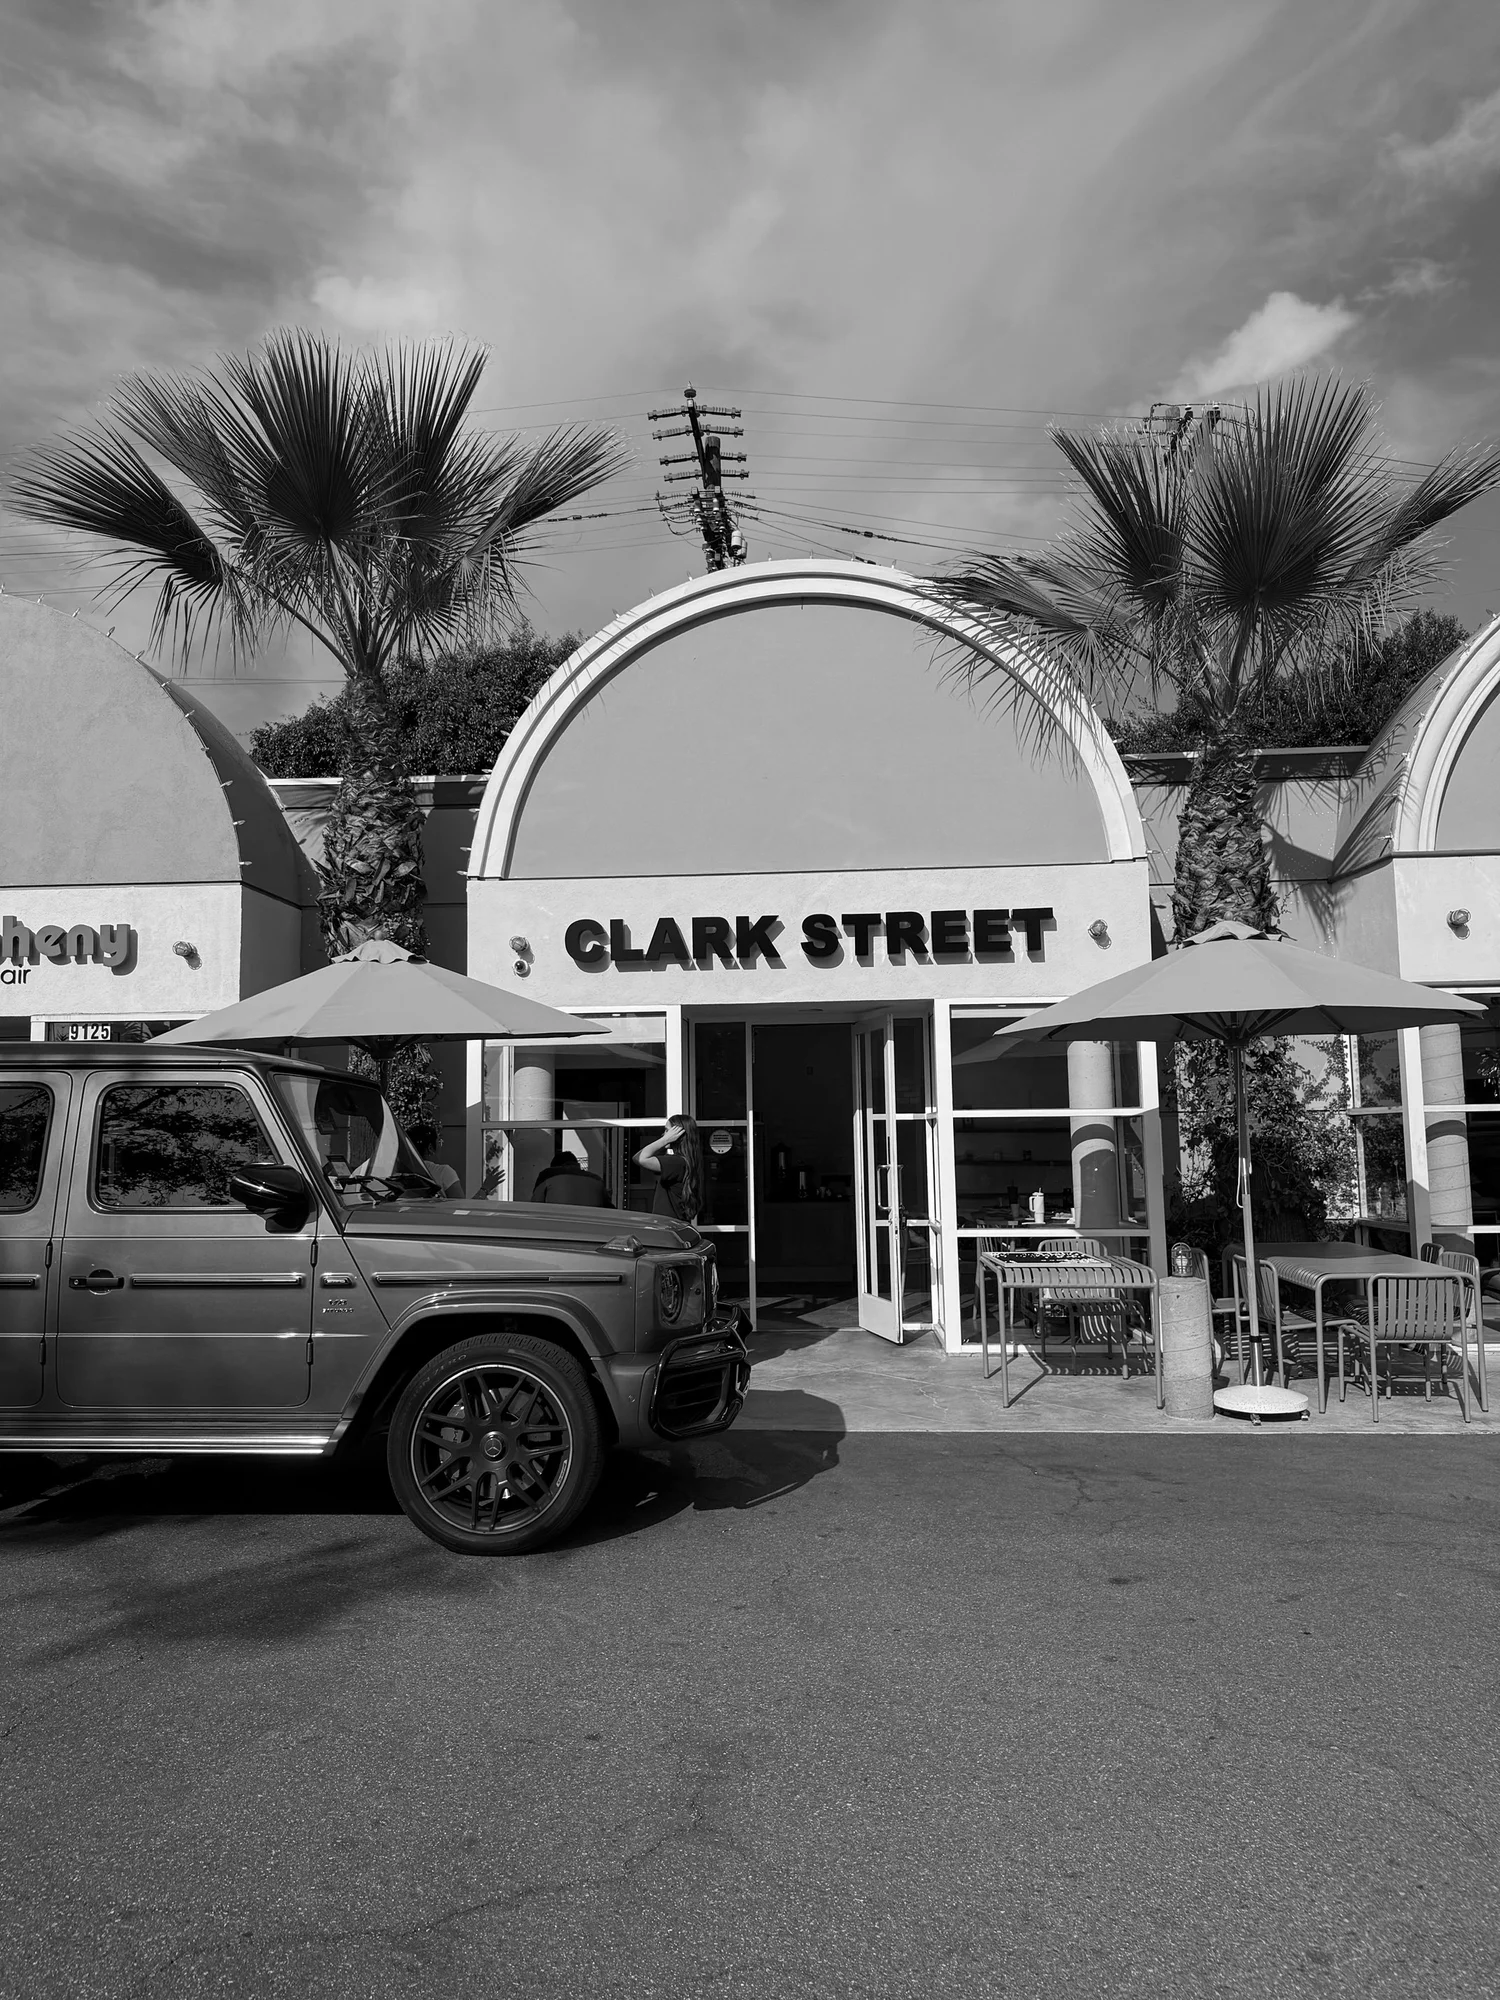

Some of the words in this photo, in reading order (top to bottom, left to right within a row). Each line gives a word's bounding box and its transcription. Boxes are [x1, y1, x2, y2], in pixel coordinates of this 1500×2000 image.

[564, 915, 783, 968] CLARK
[800, 907, 1055, 964] STREET
[0, 964, 31, 985] air
[69, 1024, 109, 1040] 9125
